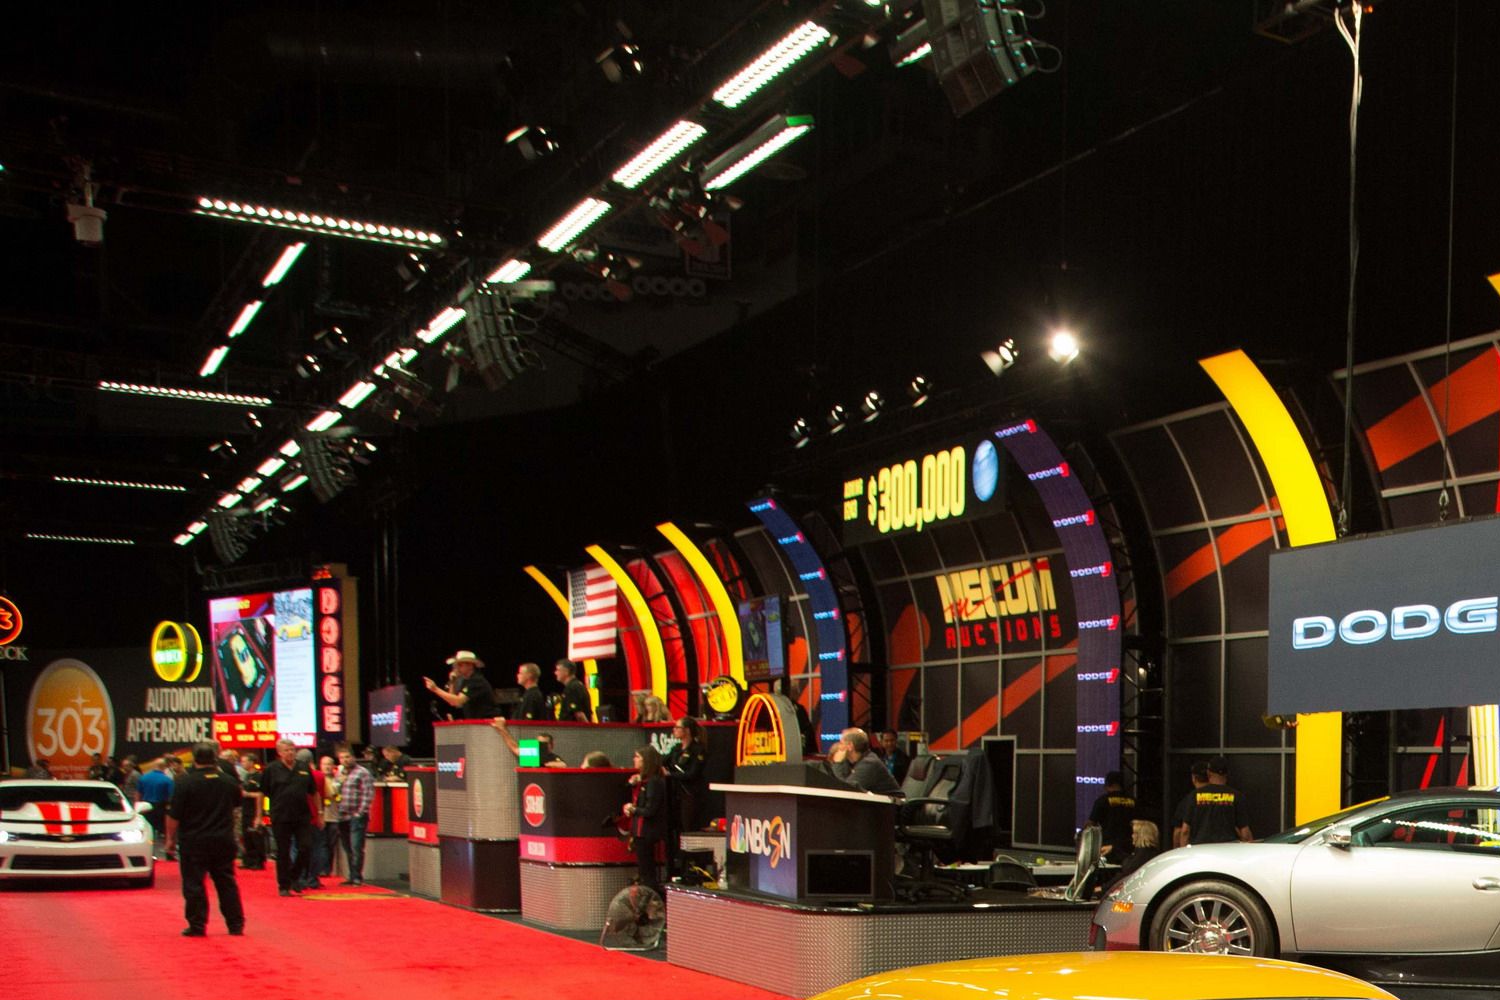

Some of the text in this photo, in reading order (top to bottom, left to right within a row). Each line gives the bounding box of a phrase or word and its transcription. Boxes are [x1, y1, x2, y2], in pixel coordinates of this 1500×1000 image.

[1028, 466, 1064, 480] DODGE
[1053, 514, 1089, 528] DODGE
[1070, 566, 1107, 577] DODGE
[936, 557, 1057, 624] MECUM
[1078, 619, 1113, 629] DODGE
[945, 615, 1062, 648] AUCTIONS
[1077, 672, 1112, 681] DODGE
[37, 707, 104, 757] 303
[126, 717, 211, 742] APPEARANCE
[1077, 724, 1112, 733] DODGE
[1076, 776, 1105, 785] DODG
[1196, 792, 1234, 803] MECUM
[745, 816, 790, 869] NBCSN
